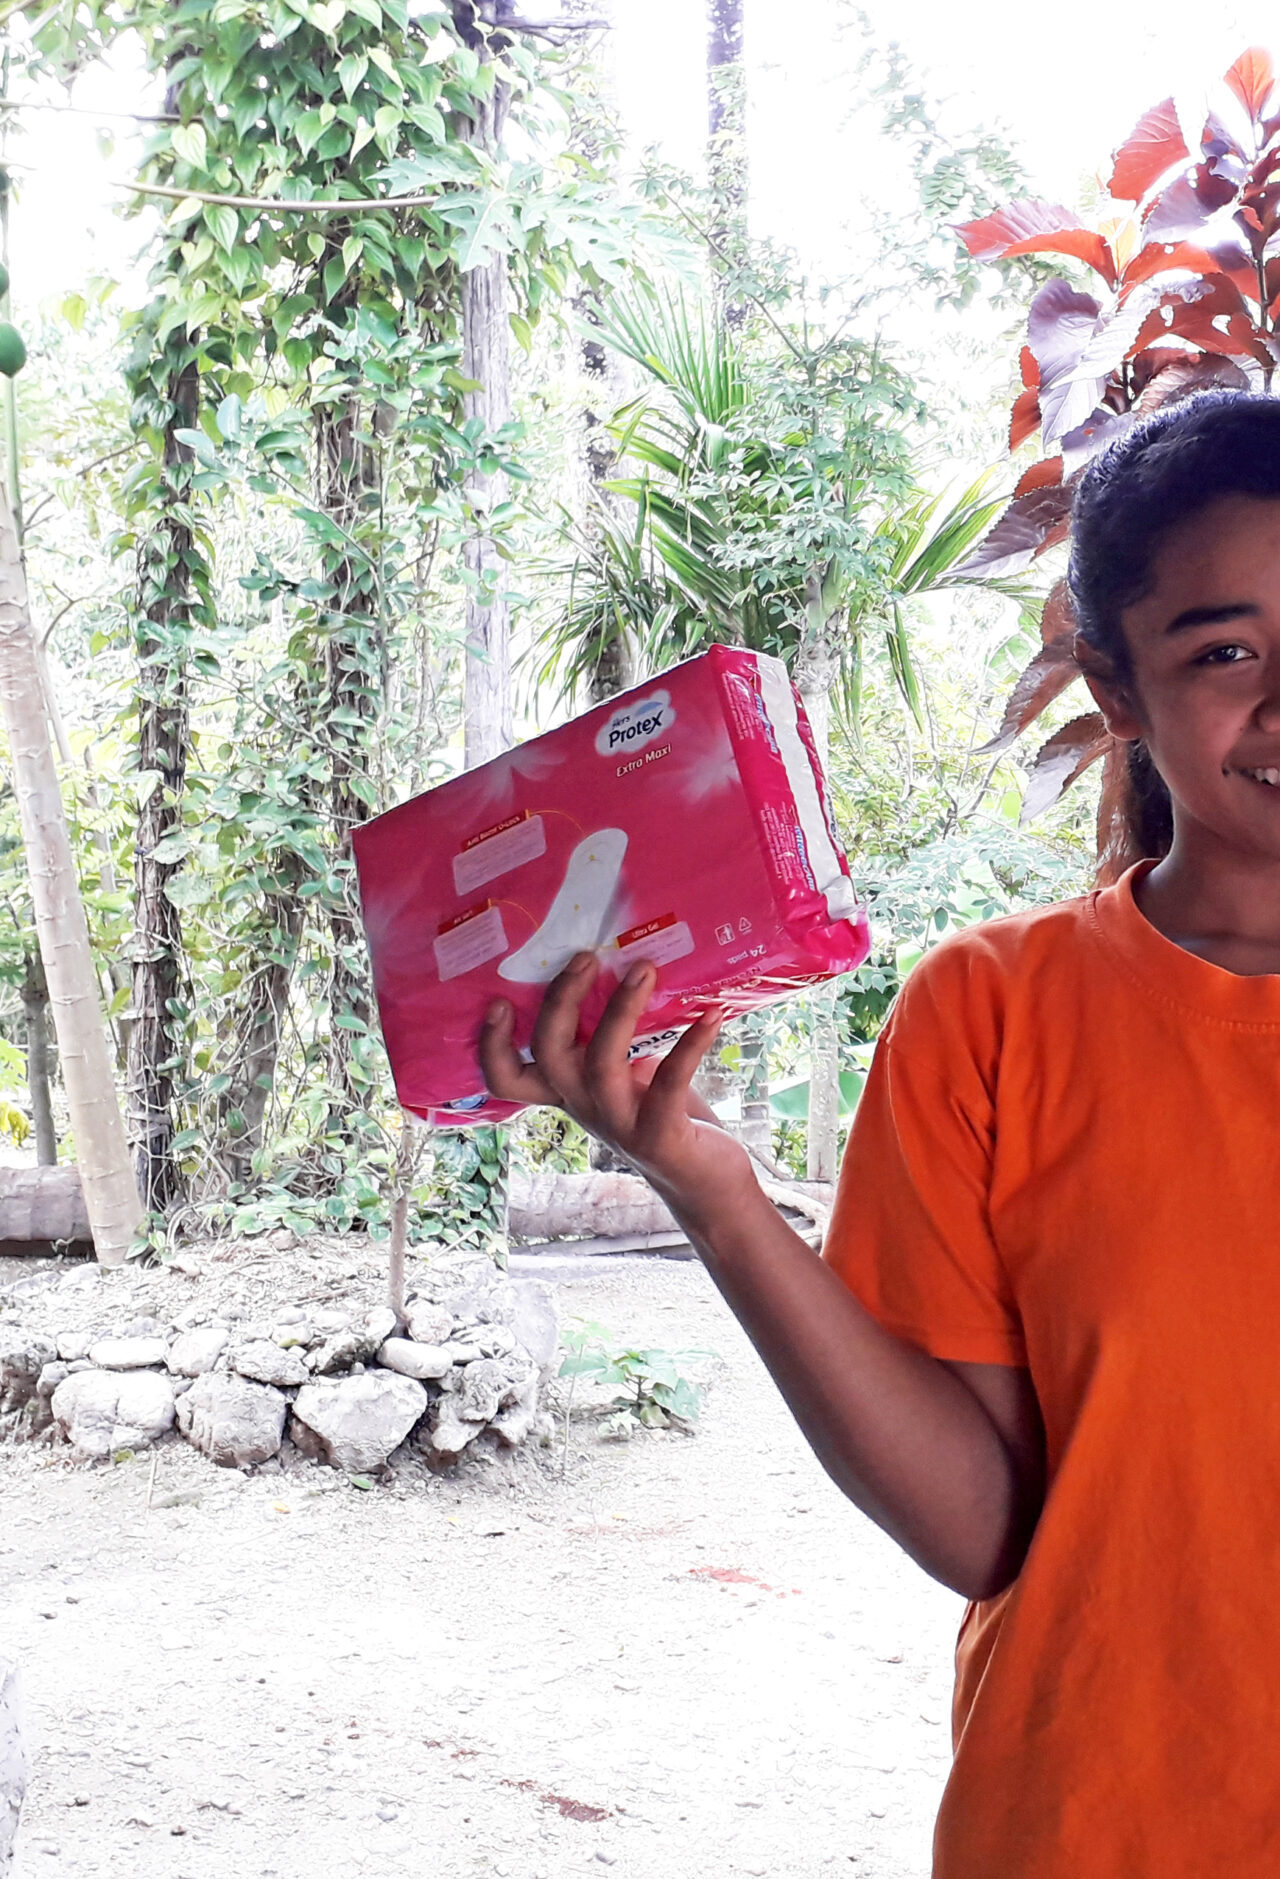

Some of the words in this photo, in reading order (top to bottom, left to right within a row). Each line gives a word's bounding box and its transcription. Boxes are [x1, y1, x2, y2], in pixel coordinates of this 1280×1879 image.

[609, 709, 664, 748] Protex
[616, 758, 643, 777] Extra
[645, 743, 671, 763] Maxi
[750, 944, 767, 958] 24
